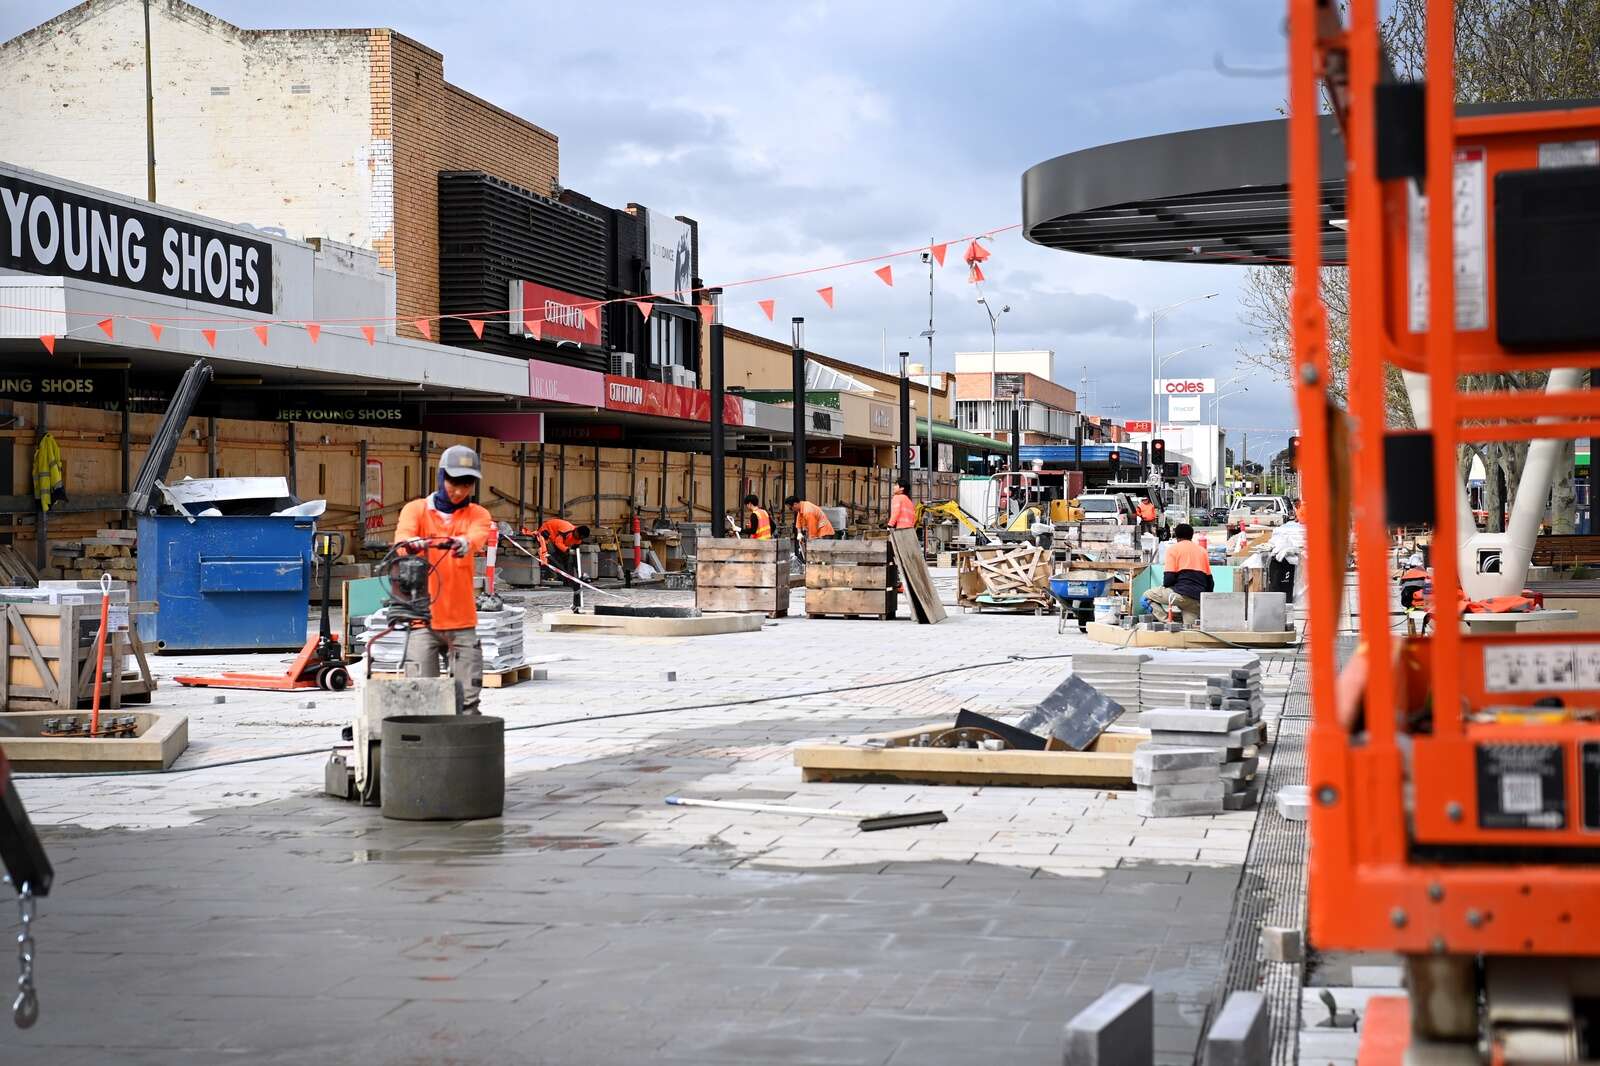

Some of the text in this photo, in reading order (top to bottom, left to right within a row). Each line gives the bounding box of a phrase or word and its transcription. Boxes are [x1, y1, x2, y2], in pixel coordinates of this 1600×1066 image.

[0, 187, 260, 305] YOUNG SHOES
[544, 299, 586, 331] COTTON ON
[41, 379, 94, 393] SHOES
[1165, 381, 1204, 393] coles
[276, 409, 402, 420] JEFF YOUNG SHOES
